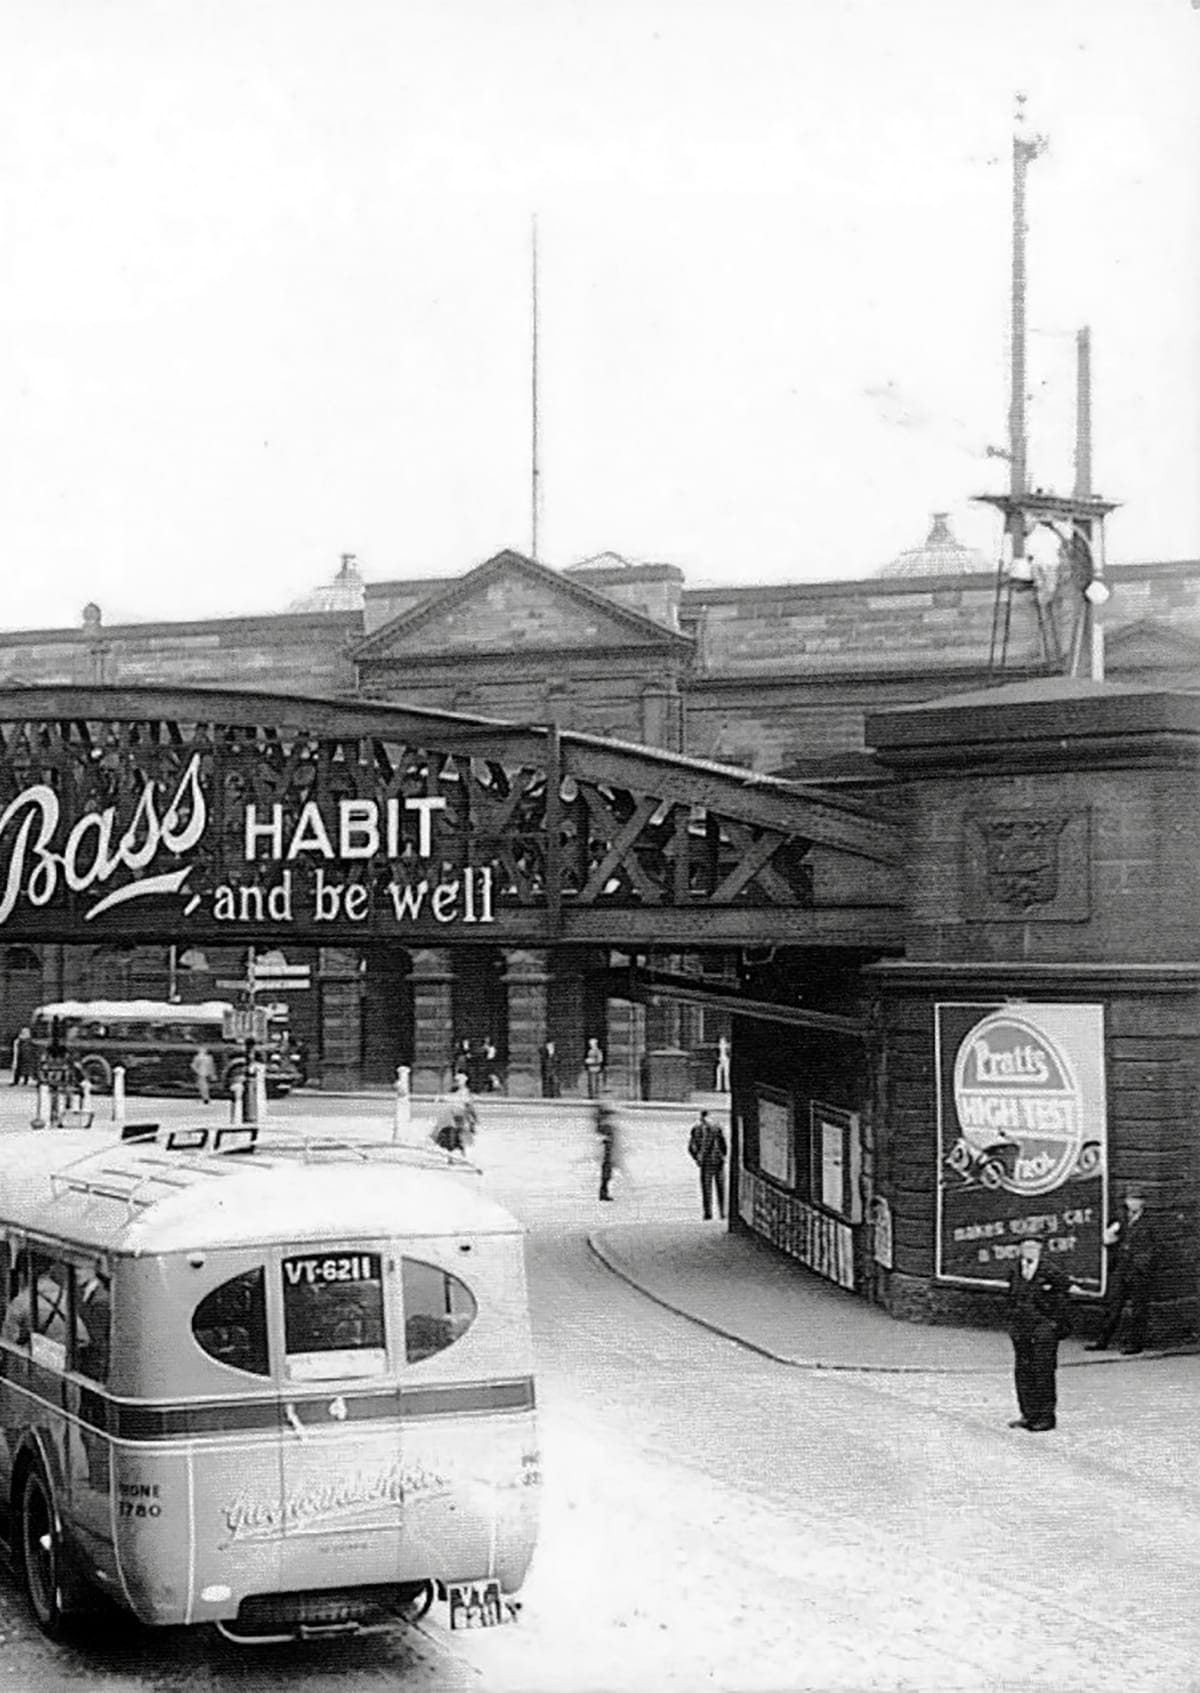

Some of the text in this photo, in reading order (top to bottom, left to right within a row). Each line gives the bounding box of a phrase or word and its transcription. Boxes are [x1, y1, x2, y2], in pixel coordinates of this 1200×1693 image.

[244, 796, 447, 860] HABIT
[314, 868, 369, 920] be
[387, 866, 495, 922] well
[961, 1096, 1074, 1133] HIGH TEST
[1063, 1206, 1093, 1224] car
[1048, 1236, 1077, 1252] car
